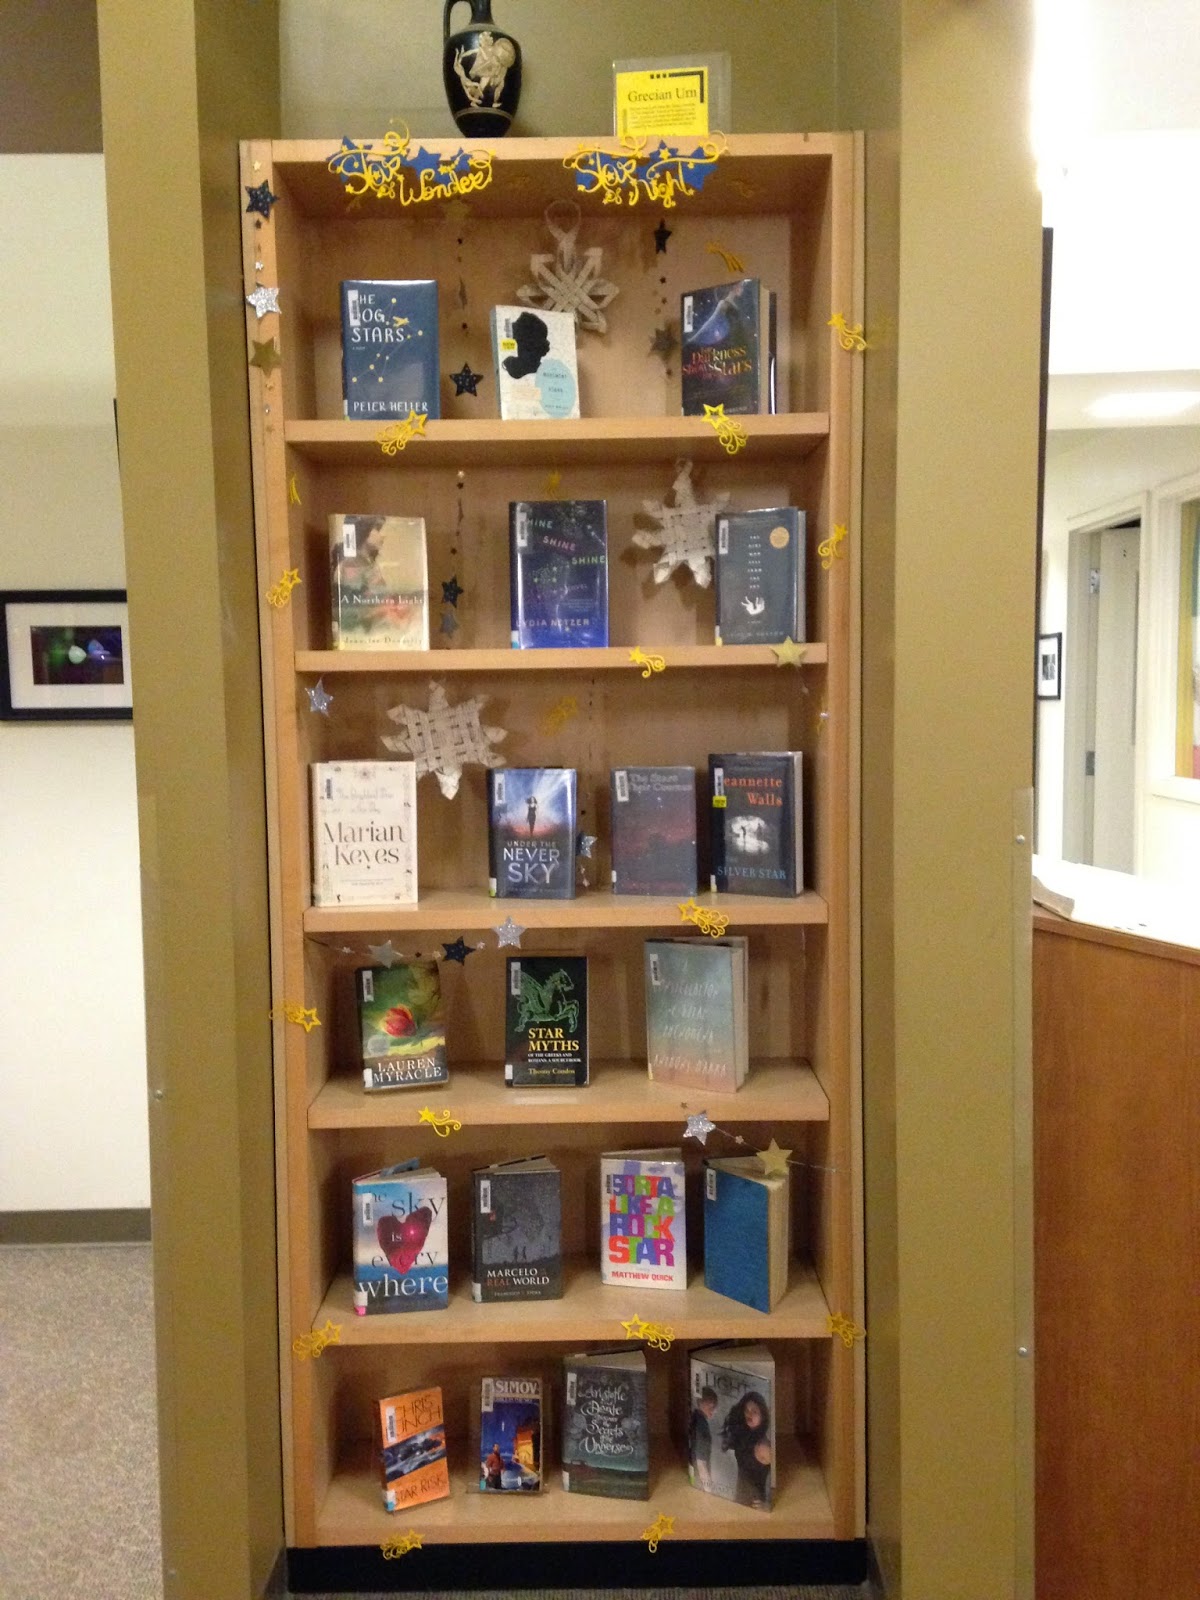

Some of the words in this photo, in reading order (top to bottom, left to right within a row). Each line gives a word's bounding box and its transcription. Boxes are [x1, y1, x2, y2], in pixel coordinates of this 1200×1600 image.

[628, 88, 673, 103] Grecian
[675, 87, 697, 100] Urn
[400, 162, 492, 206] Wonder
[628, 158, 702, 208] Night
[359, 293, 376, 305] HE
[359, 307, 387, 323] OG
[351, 326, 405, 343] STARS
[353, 401, 387, 412] PETER
[527, 518, 553, 529] HINE
[542, 535, 577, 551] SHINE
[571, 555, 607, 565] SHINE
[341, 594, 350, 604] A
[551, 618, 590, 627] NETZER
[723, 776, 783, 787] eannette
[747, 791, 784, 806] Walls
[324, 821, 407, 844] Marian
[335, 844, 400, 869] Keyes
[503, 848, 560, 862] NEVER
[508, 862, 559, 884] SKY
[717, 865, 756, 877] SILVER
[759, 868, 787, 880] STAR
[528, 1027, 565, 1039] STAR
[528, 1040, 580, 1051] MYTHS
[378, 1057, 436, 1072] LAUREN
[374, 1066, 442, 1083] MYRACLE
[612, 1174, 675, 1198] SORTA
[391, 1191, 446, 1222] sky
[609, 1213, 676, 1242] ROCK
[391, 1231, 402, 1242] is
[608, 1235, 675, 1267] STAR
[487, 1267, 538, 1278] MARCELO
[611, 1270, 650, 1281] MATTHEW
[652, 1273, 674, 1282] QUICK
[359, 1273, 448, 1298] where
[512, 1276, 550, 1286] WORLD
